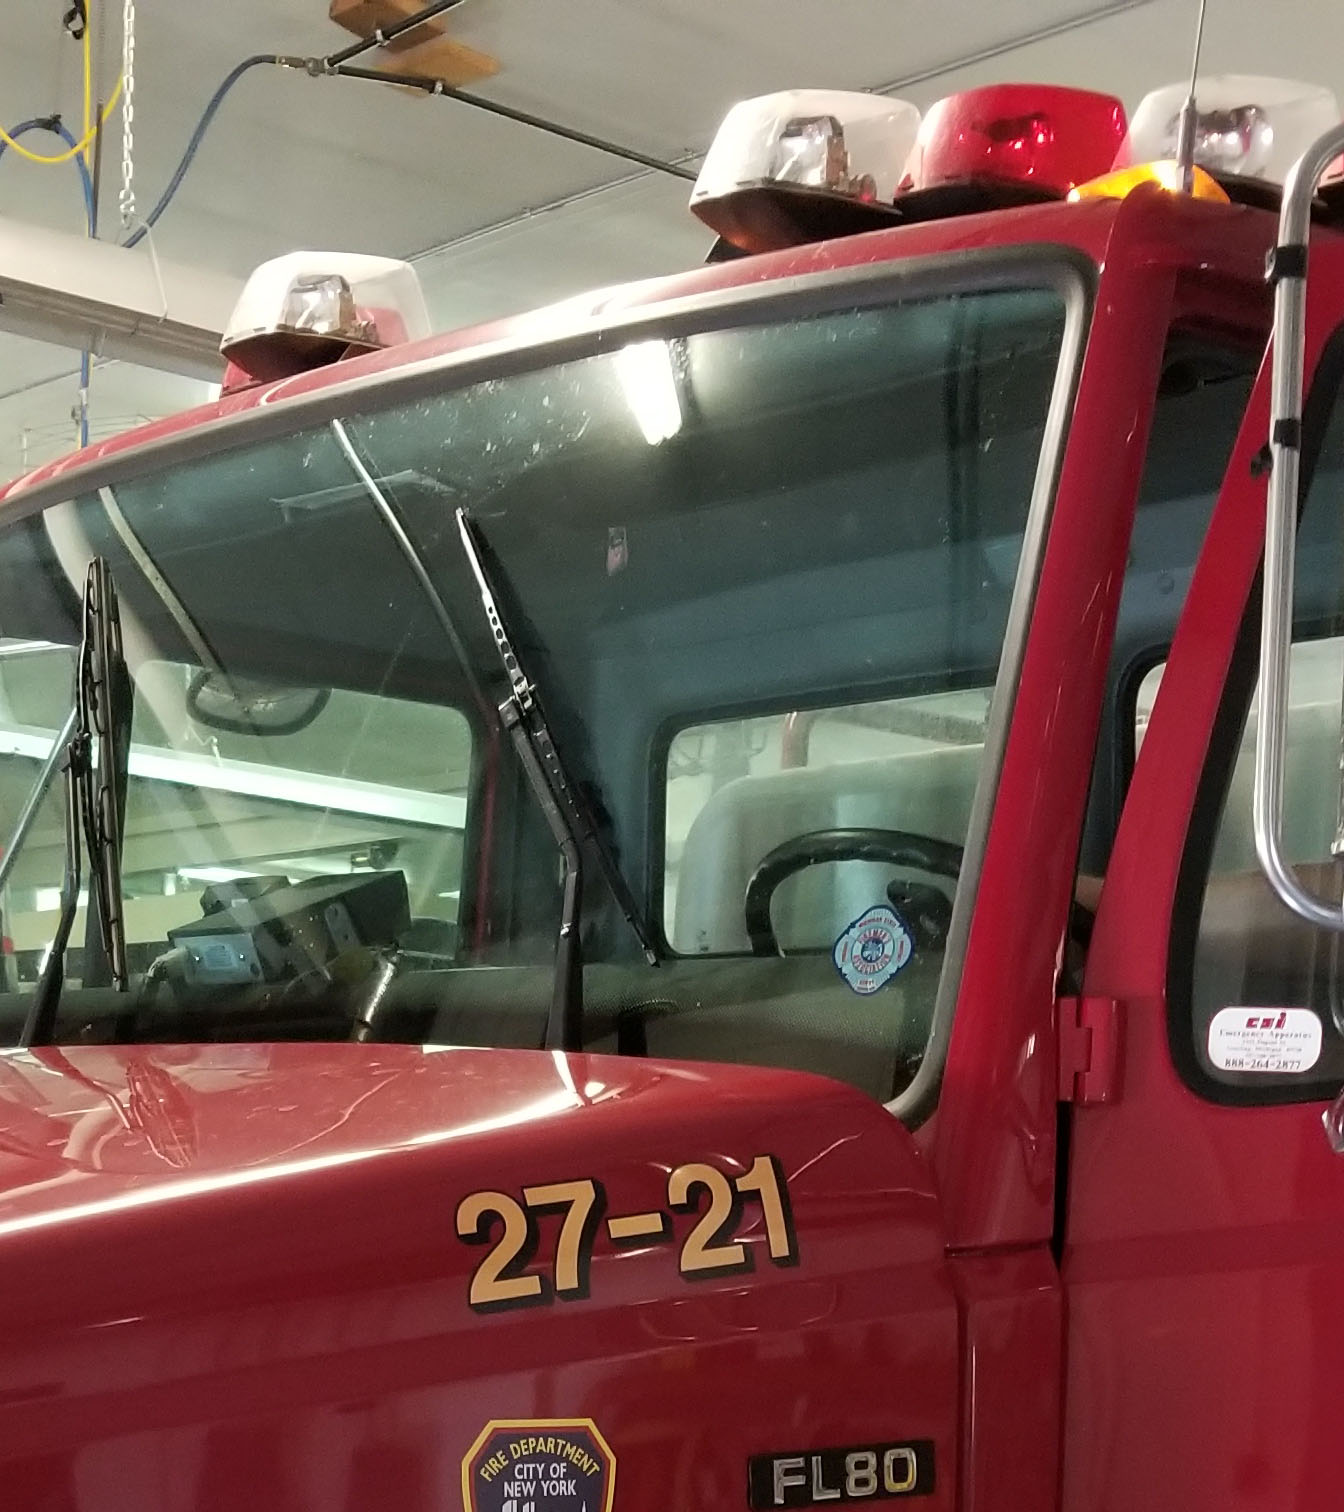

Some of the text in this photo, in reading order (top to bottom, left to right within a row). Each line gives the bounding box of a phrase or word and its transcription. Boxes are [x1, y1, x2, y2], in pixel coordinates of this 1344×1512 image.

[456, 1155, 796, 1312] 27-21
[479, 1437, 601, 1482] FIRE DEPARTMENT
[514, 1462, 567, 1479] CITY OF
[772, 1446, 918, 1505] FL80
[504, 1479, 577, 1498] NEW YORK
